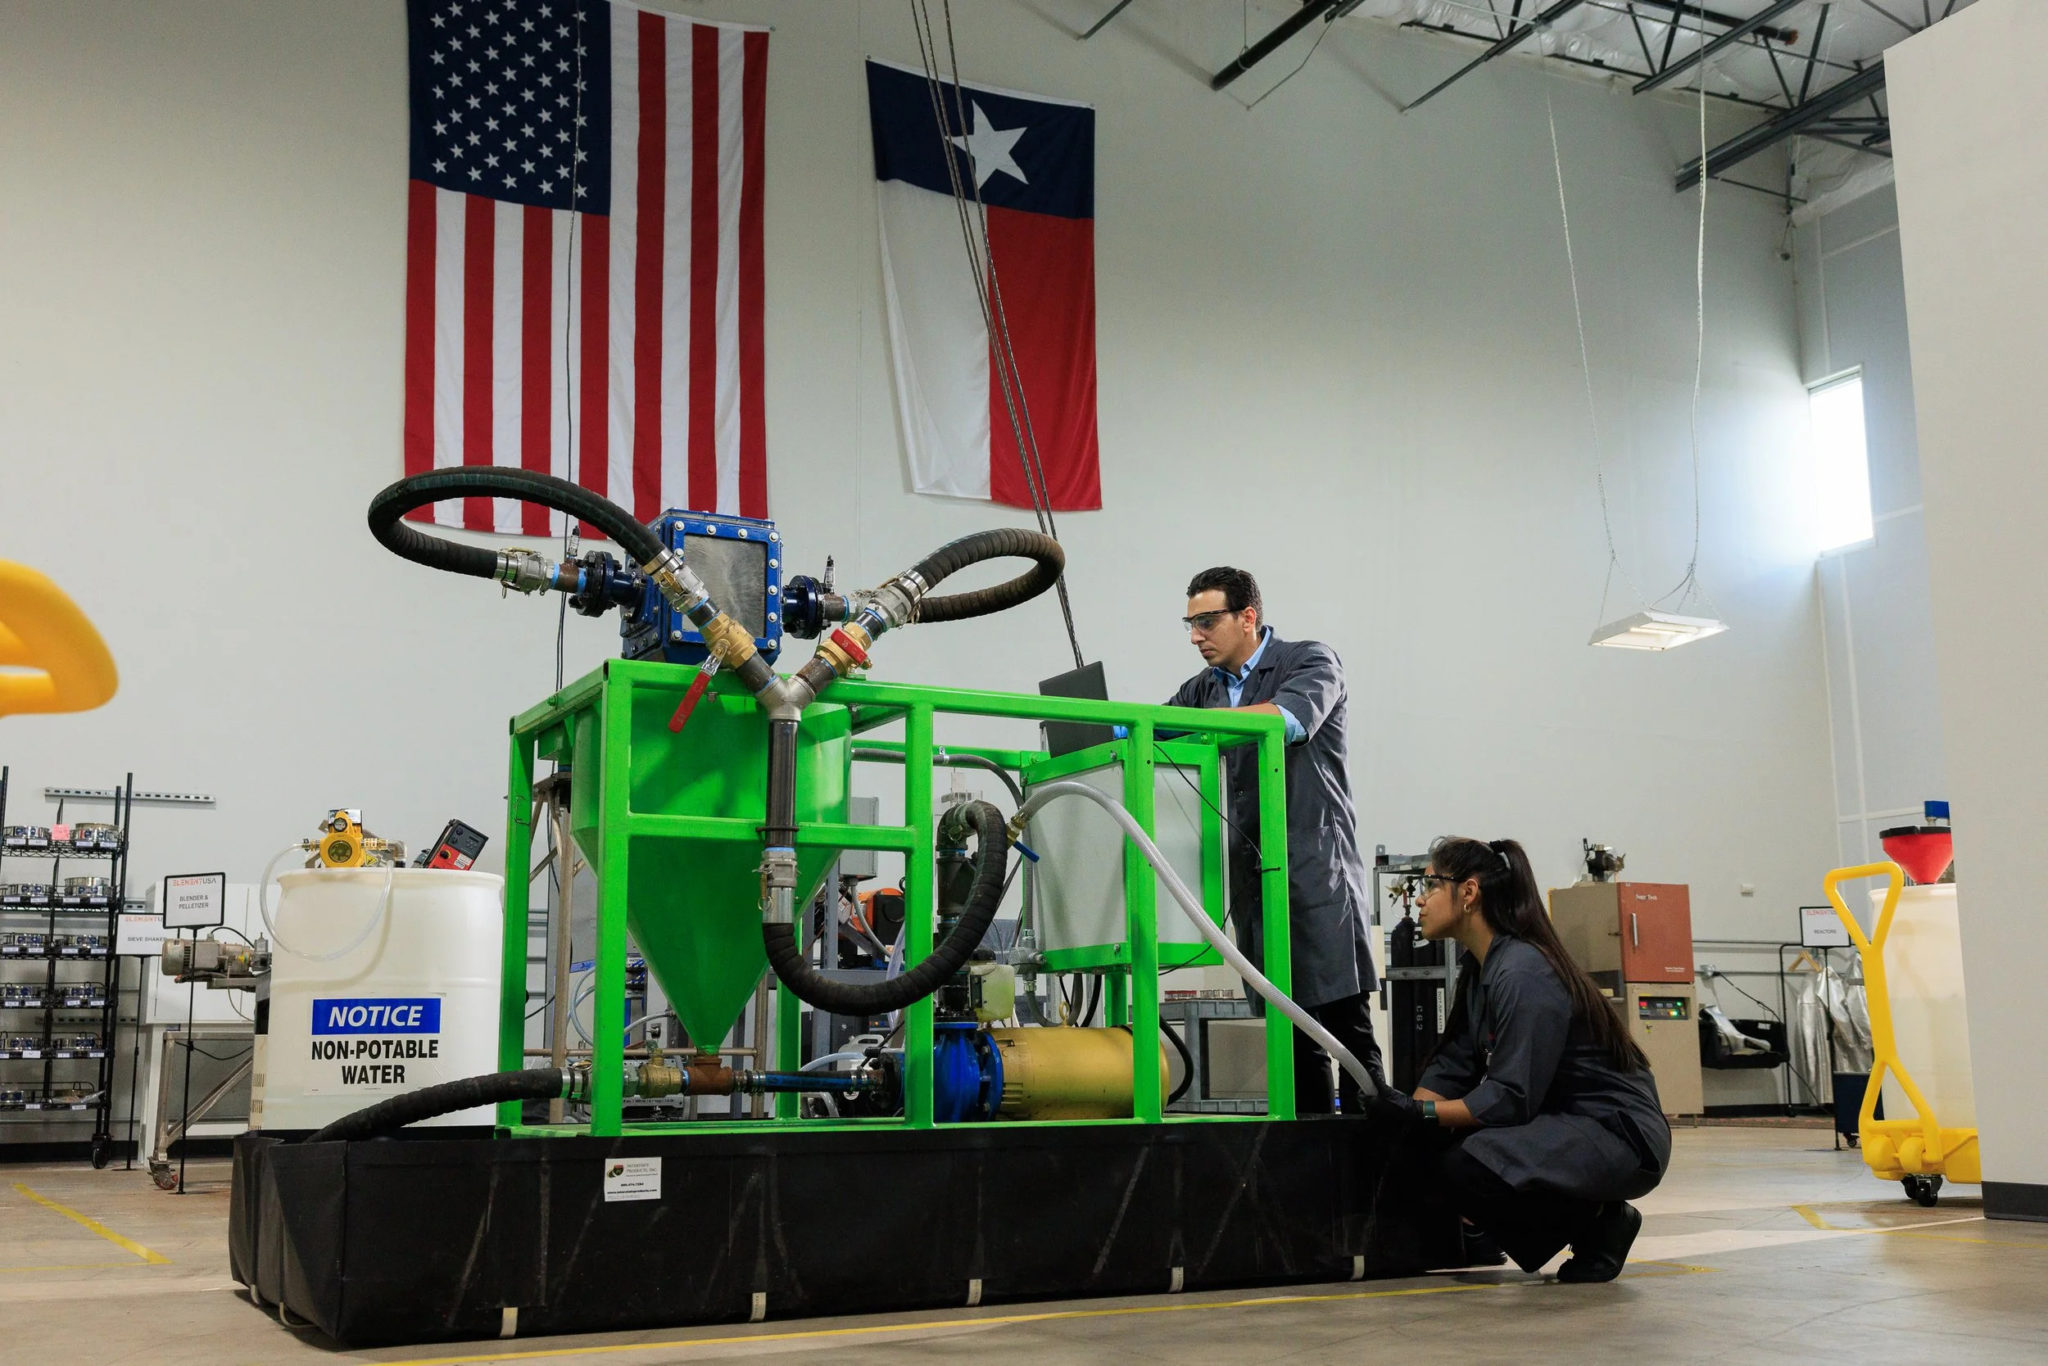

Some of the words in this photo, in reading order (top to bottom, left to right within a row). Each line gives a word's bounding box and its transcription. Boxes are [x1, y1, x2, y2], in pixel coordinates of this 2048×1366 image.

[178, 902, 209, 910] PELLETIZER
[328, 1005, 424, 1027] NOTICE
[311, 1039, 439, 1060] NON-POTABLE
[341, 1064, 405, 1085] WATER
